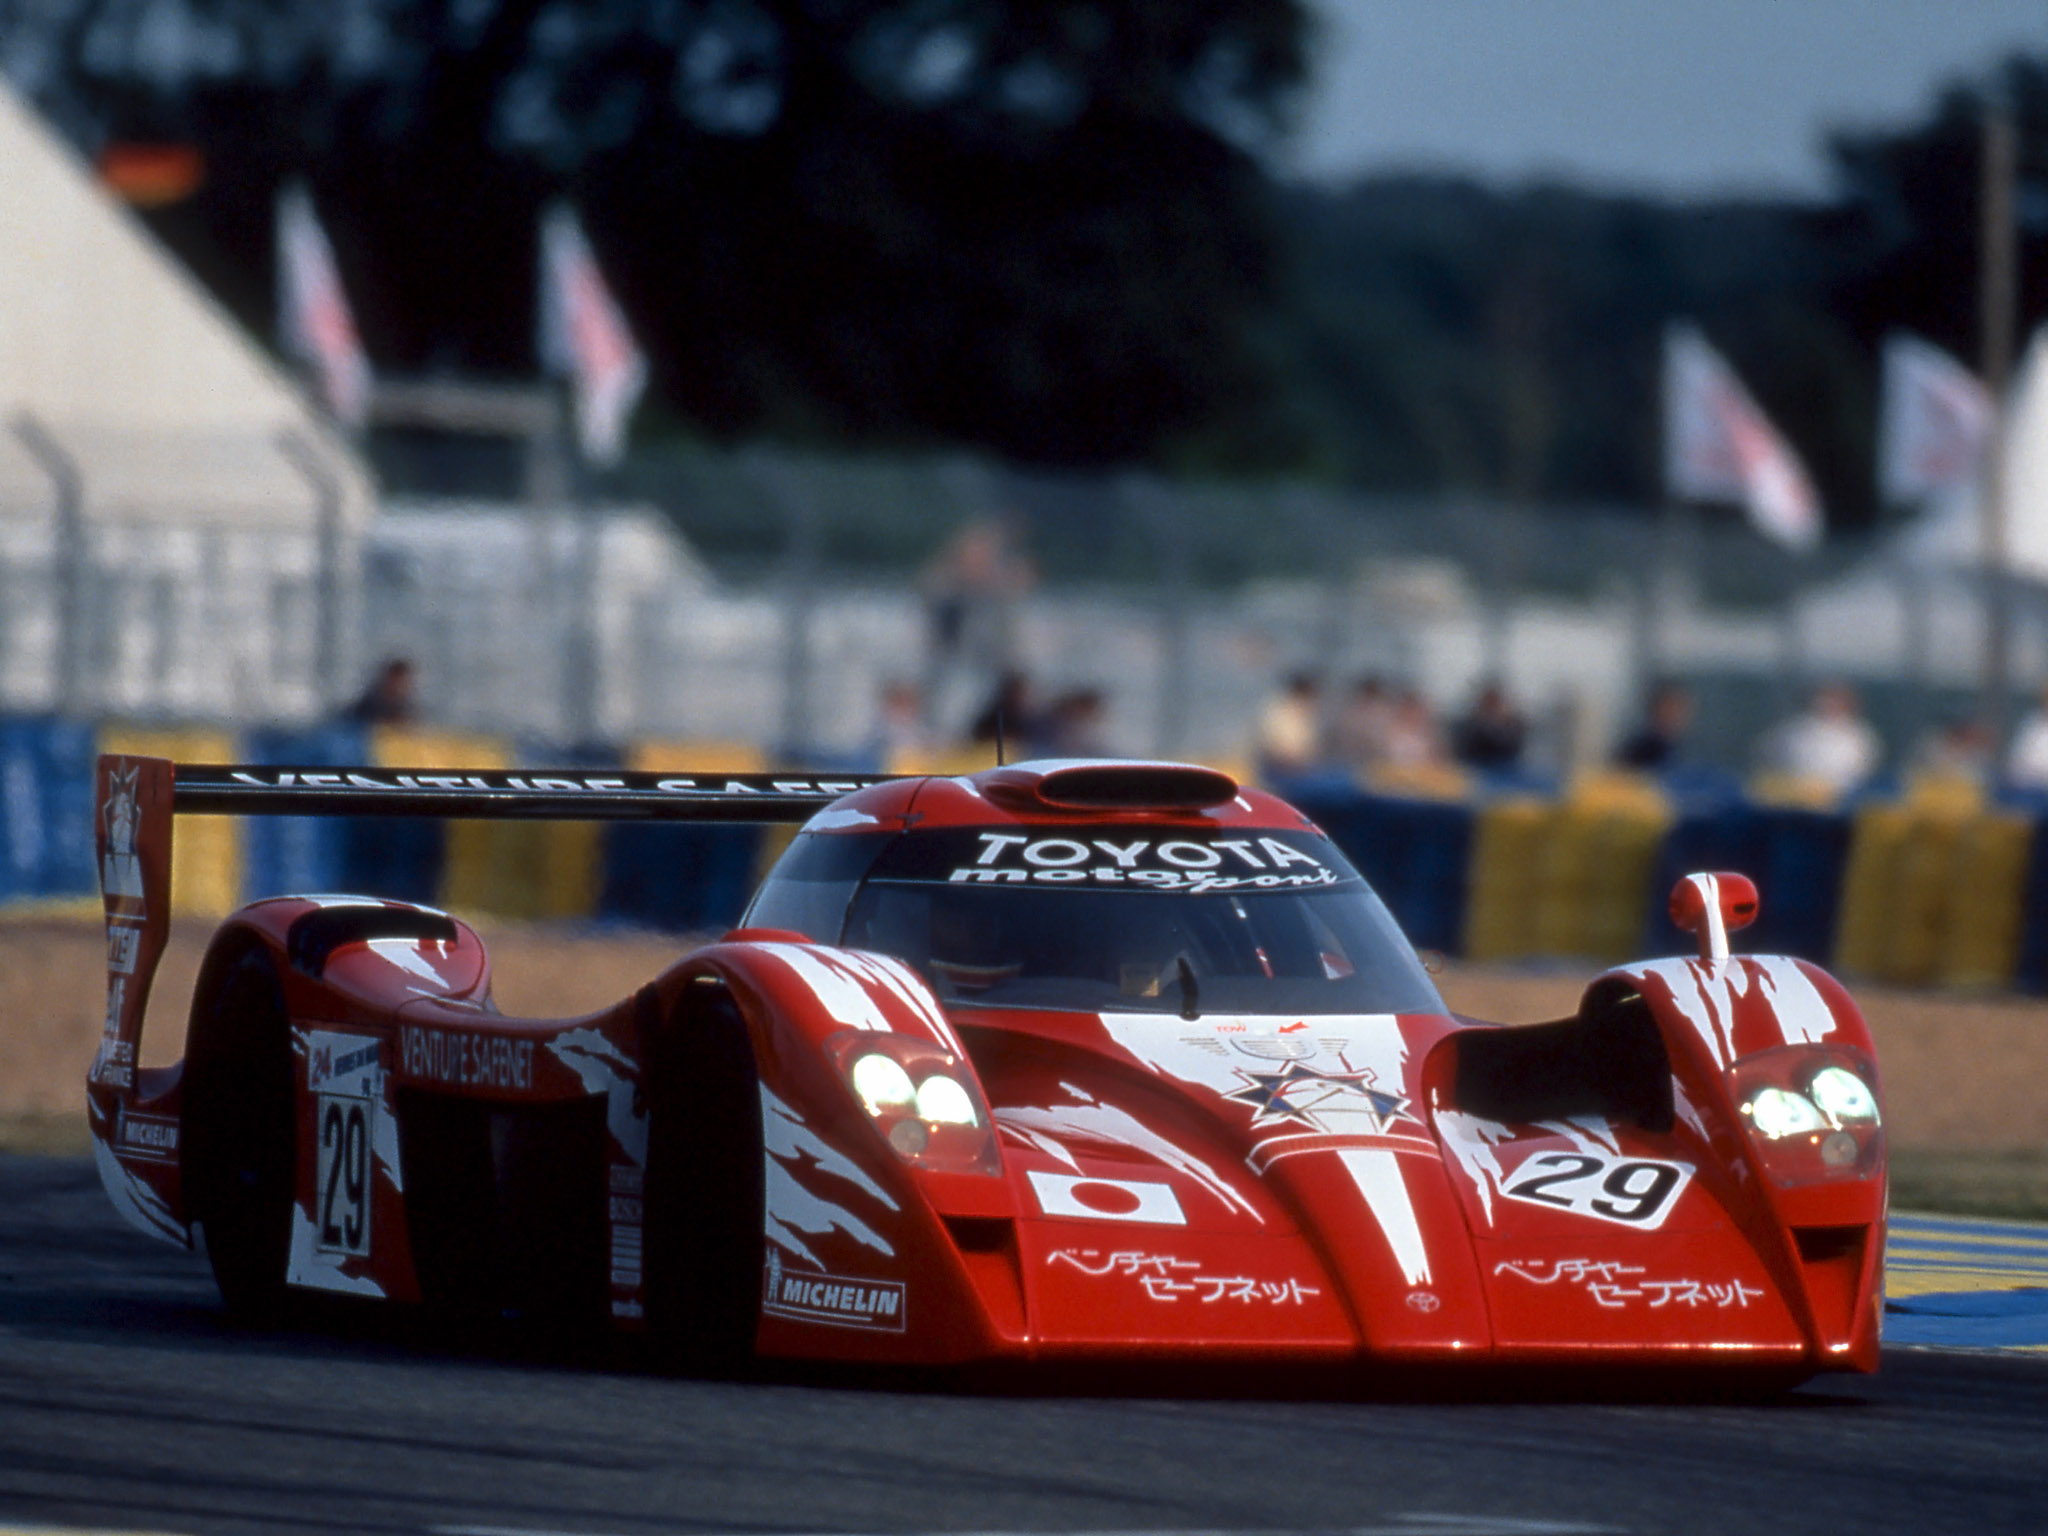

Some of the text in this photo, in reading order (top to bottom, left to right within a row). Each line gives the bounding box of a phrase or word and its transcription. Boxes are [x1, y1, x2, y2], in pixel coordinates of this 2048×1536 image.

[976, 833, 1321, 868] TOYOTA
[471, 1033, 534, 1089] SAFENET
[322, 1102, 366, 1249] 29
[1507, 1154, 1682, 1222] 29
[1047, 1248, 1201, 1275] ベンチャー
[1494, 1259, 1646, 1284] ベンチャー
[783, 1278, 899, 1315] MICHELIN
[1139, 1274, 1320, 1304] セーフネット
[1587, 1278, 1765, 1308] セーフネット
